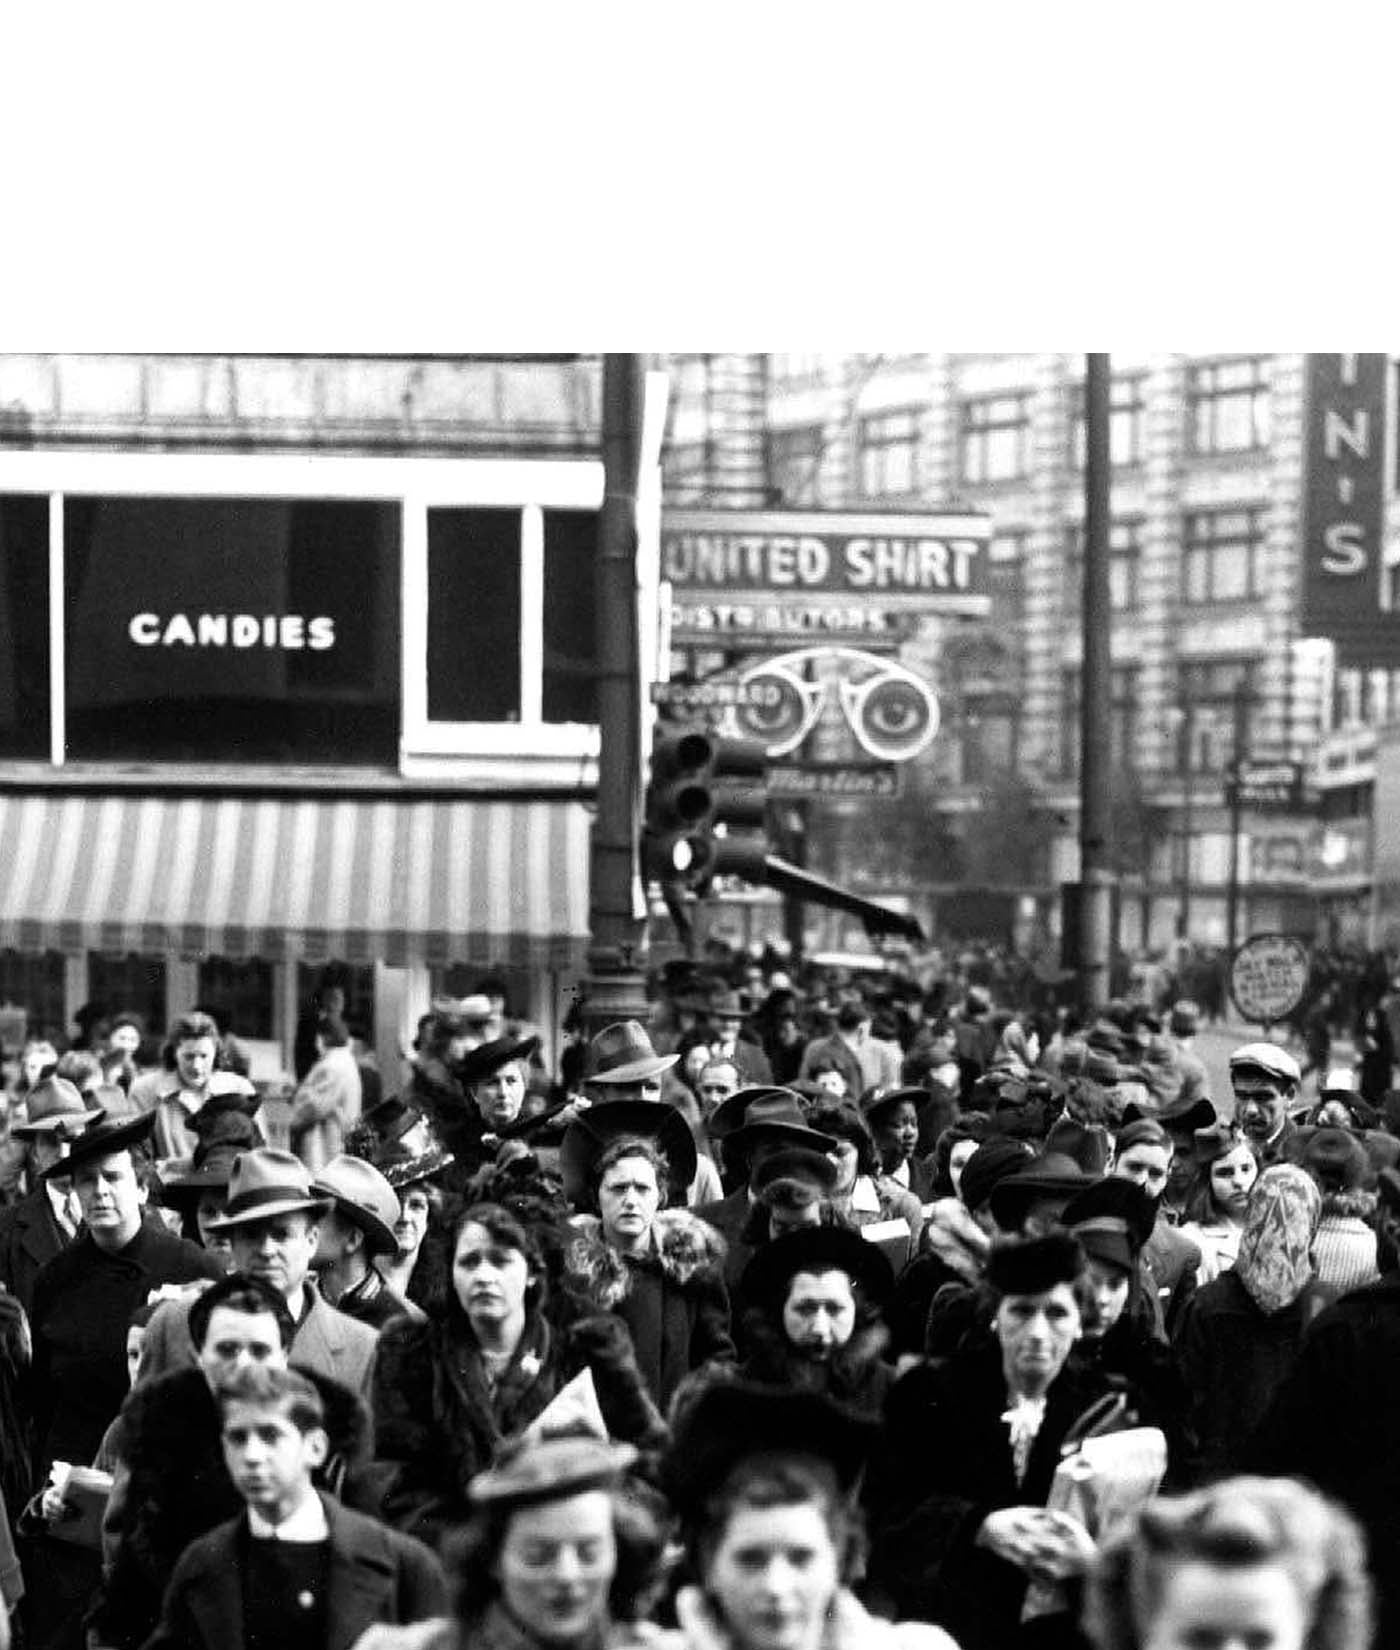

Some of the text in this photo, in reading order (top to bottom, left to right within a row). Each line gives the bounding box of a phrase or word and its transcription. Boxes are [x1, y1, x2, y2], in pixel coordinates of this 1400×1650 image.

[664, 536, 979, 588] UNITED SHIRT
[128, 612, 336, 650] CANDIES
